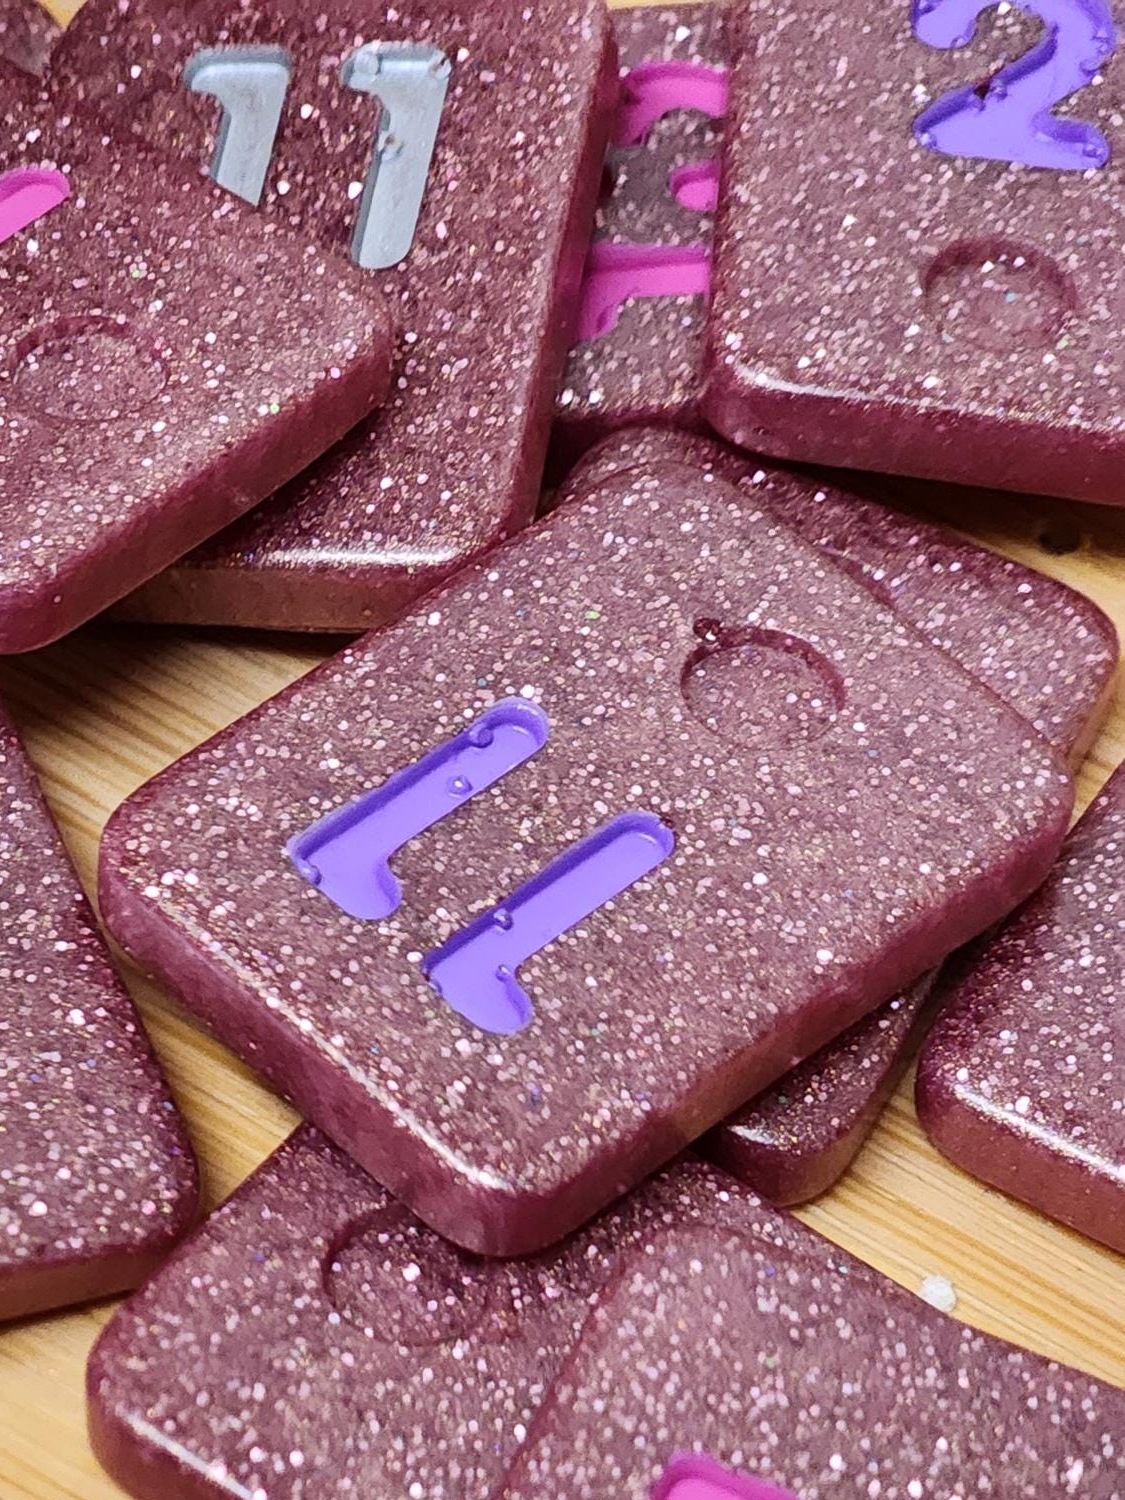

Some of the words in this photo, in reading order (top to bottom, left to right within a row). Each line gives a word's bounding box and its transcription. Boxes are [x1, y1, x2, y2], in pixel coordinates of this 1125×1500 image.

[183, 40, 452, 270] 11
[912, 0, 1112, 171] 2
[285, 698, 674, 1033] 11
